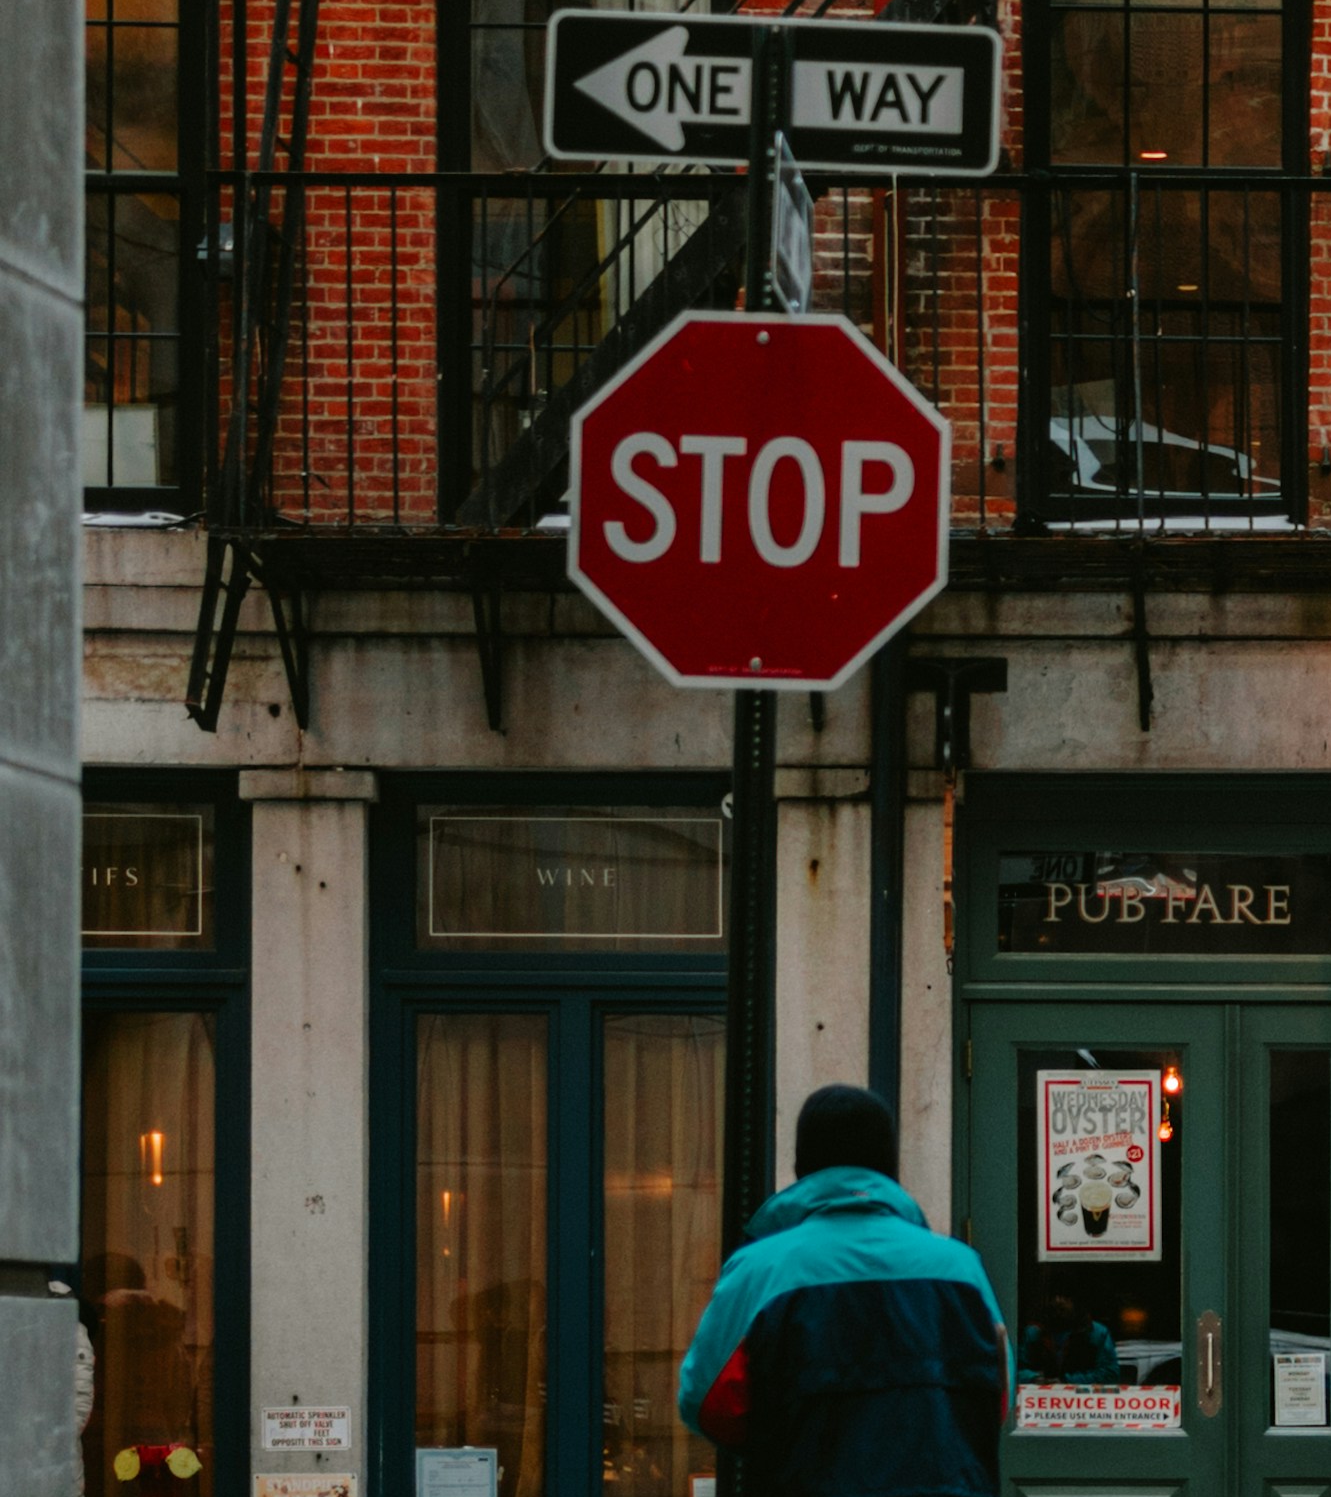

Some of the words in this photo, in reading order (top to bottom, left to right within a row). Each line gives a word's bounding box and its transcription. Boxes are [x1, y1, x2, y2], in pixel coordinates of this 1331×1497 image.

[626, 61, 740, 116] ONE
[826, 69, 947, 125] WAY
[603, 431, 915, 568] STOP
[536, 868, 616, 887] WINE
[1043, 883, 1146, 924] PUB
[1160, 884, 1292, 925] FARE
[1052, 1092, 1147, 1108] WEDNESDAY
[1052, 1107, 1146, 1135] OYSTER
[1025, 1397, 1107, 1410] SERVICE
[1114, 1397, 1171, 1410] DOOR
[267, 1412, 306, 1420] AUTOMATIC
[1034, 1412, 1067, 1420] PLEASE
[1069, 1412, 1087, 1420] USE
[1089, 1412, 1112, 1420] MAIN
[1114, 1412, 1161, 1420] ENTRANCE
[300, 1420, 311, 1428] OFF
[314, 1420, 333, 1428] VALVE
[314, 1429, 330, 1437] FEET
[271, 1438, 305, 1446] OPPOSITE
[308, 1438, 324, 1446] THIS
[326, 1438, 342, 1446] SIGN
